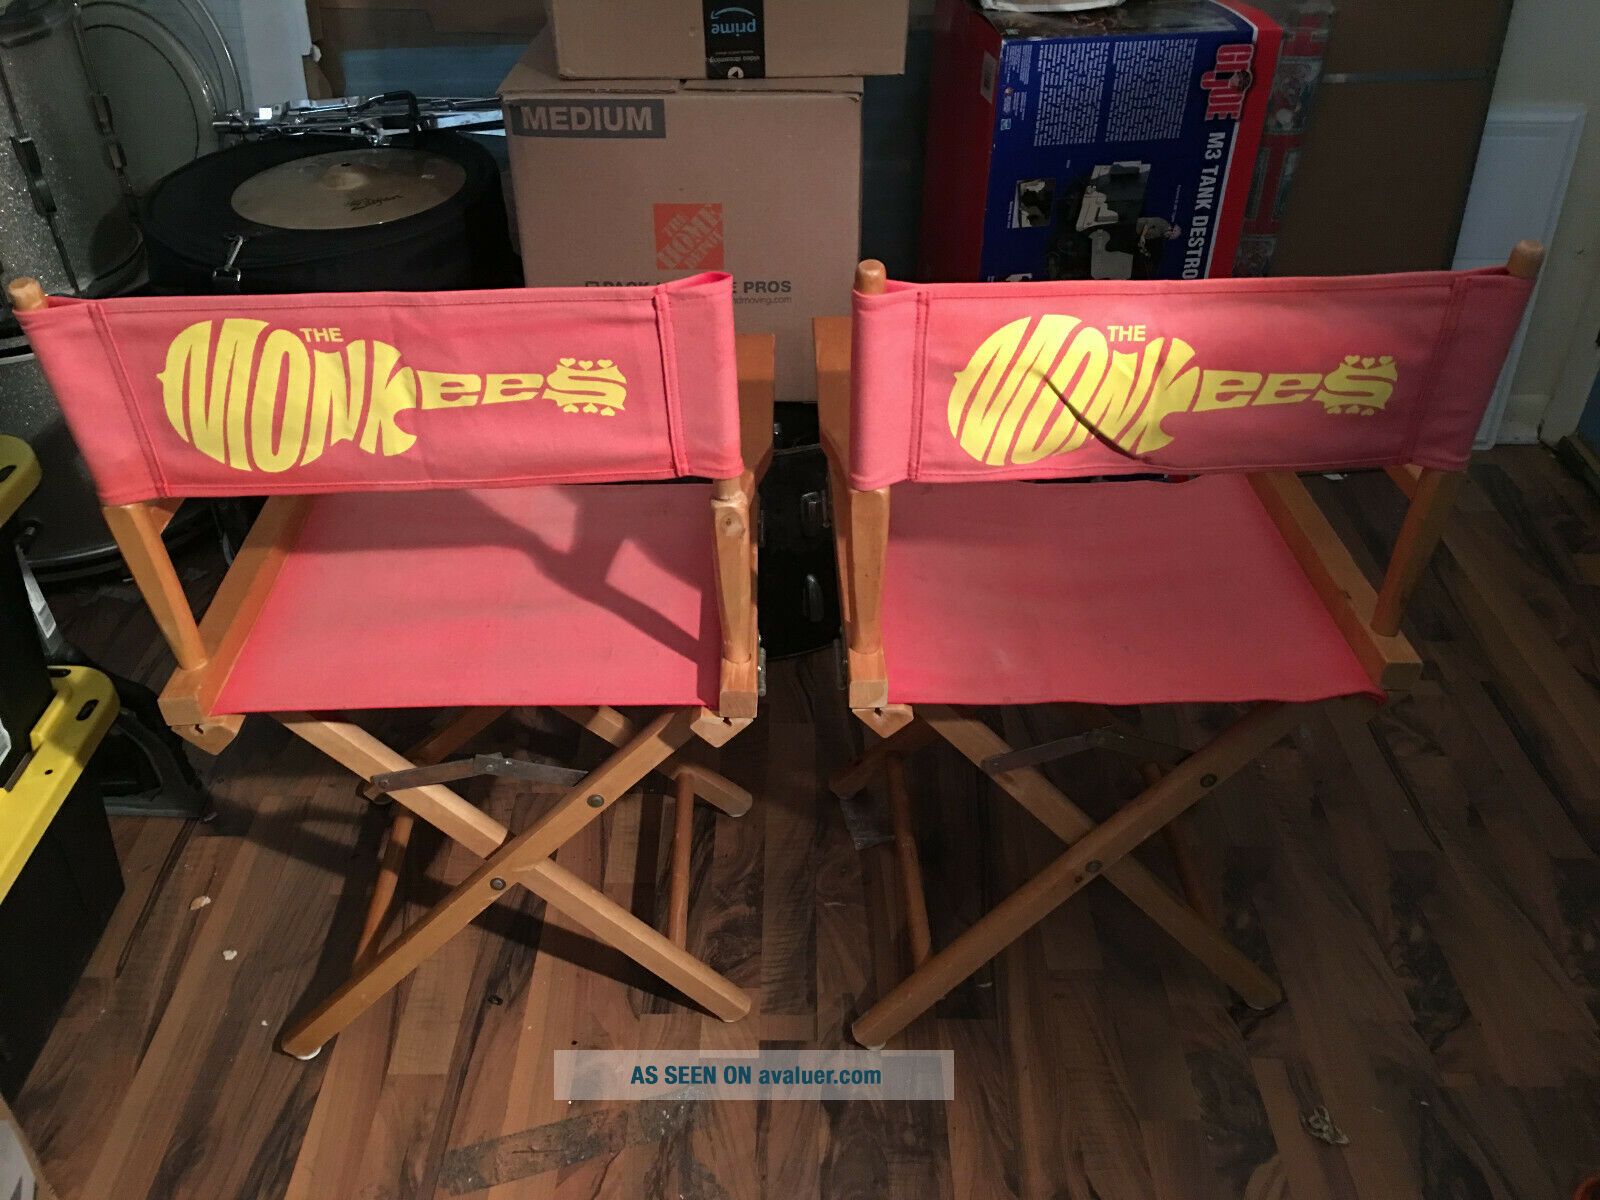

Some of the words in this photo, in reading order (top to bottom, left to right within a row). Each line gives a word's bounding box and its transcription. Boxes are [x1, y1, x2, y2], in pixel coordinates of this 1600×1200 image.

[711, 19, 757, 37] prime
[520, 106, 653, 131] MEDIUM
[1204, 132, 1226, 160] M3
[1194, 165, 1220, 211] TANK
[657, 203, 720, 270] HOME
[683, 229, 723, 270] DEPOT
[743, 280, 792, 293] PROS
[300, 326, 343, 343] THE
[1107, 325, 1146, 342] THE
